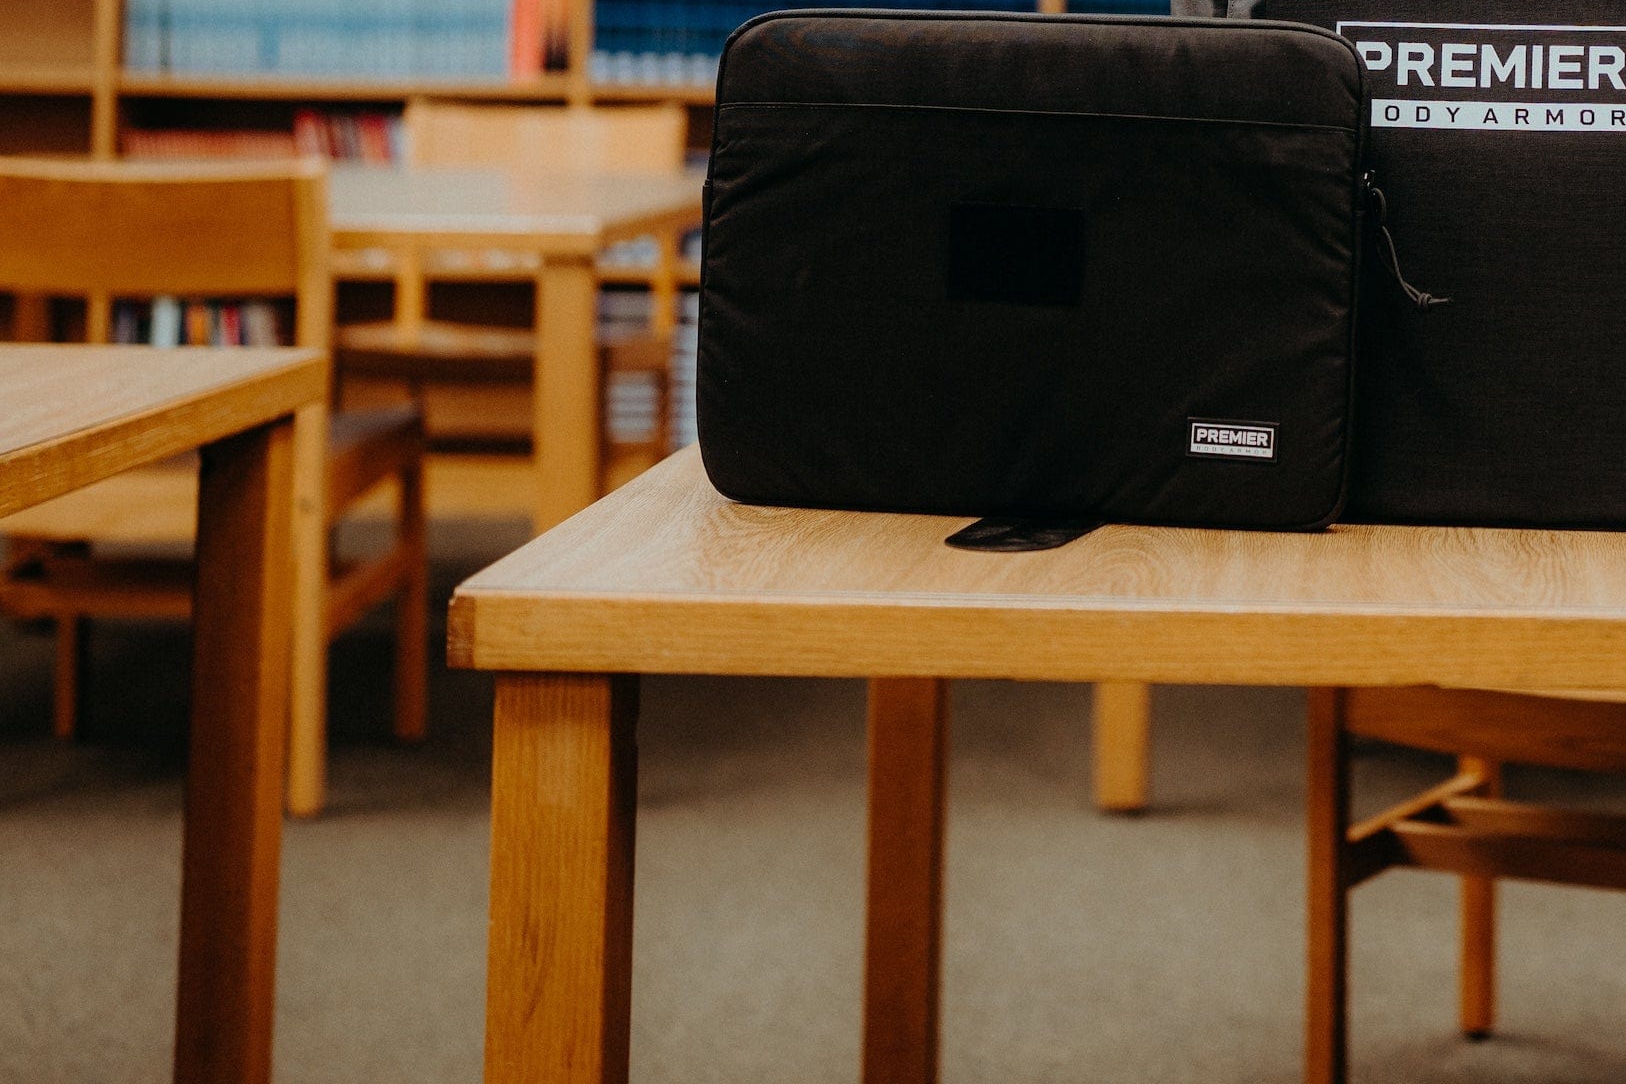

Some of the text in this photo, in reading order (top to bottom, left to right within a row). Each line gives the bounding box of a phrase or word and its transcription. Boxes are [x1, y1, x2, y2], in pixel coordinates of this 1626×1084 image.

[1356, 41, 1626, 90] PREMIER
[1384, 105, 1626, 126] ODY ARMOR
[1196, 428, 1268, 447] PREMIER
